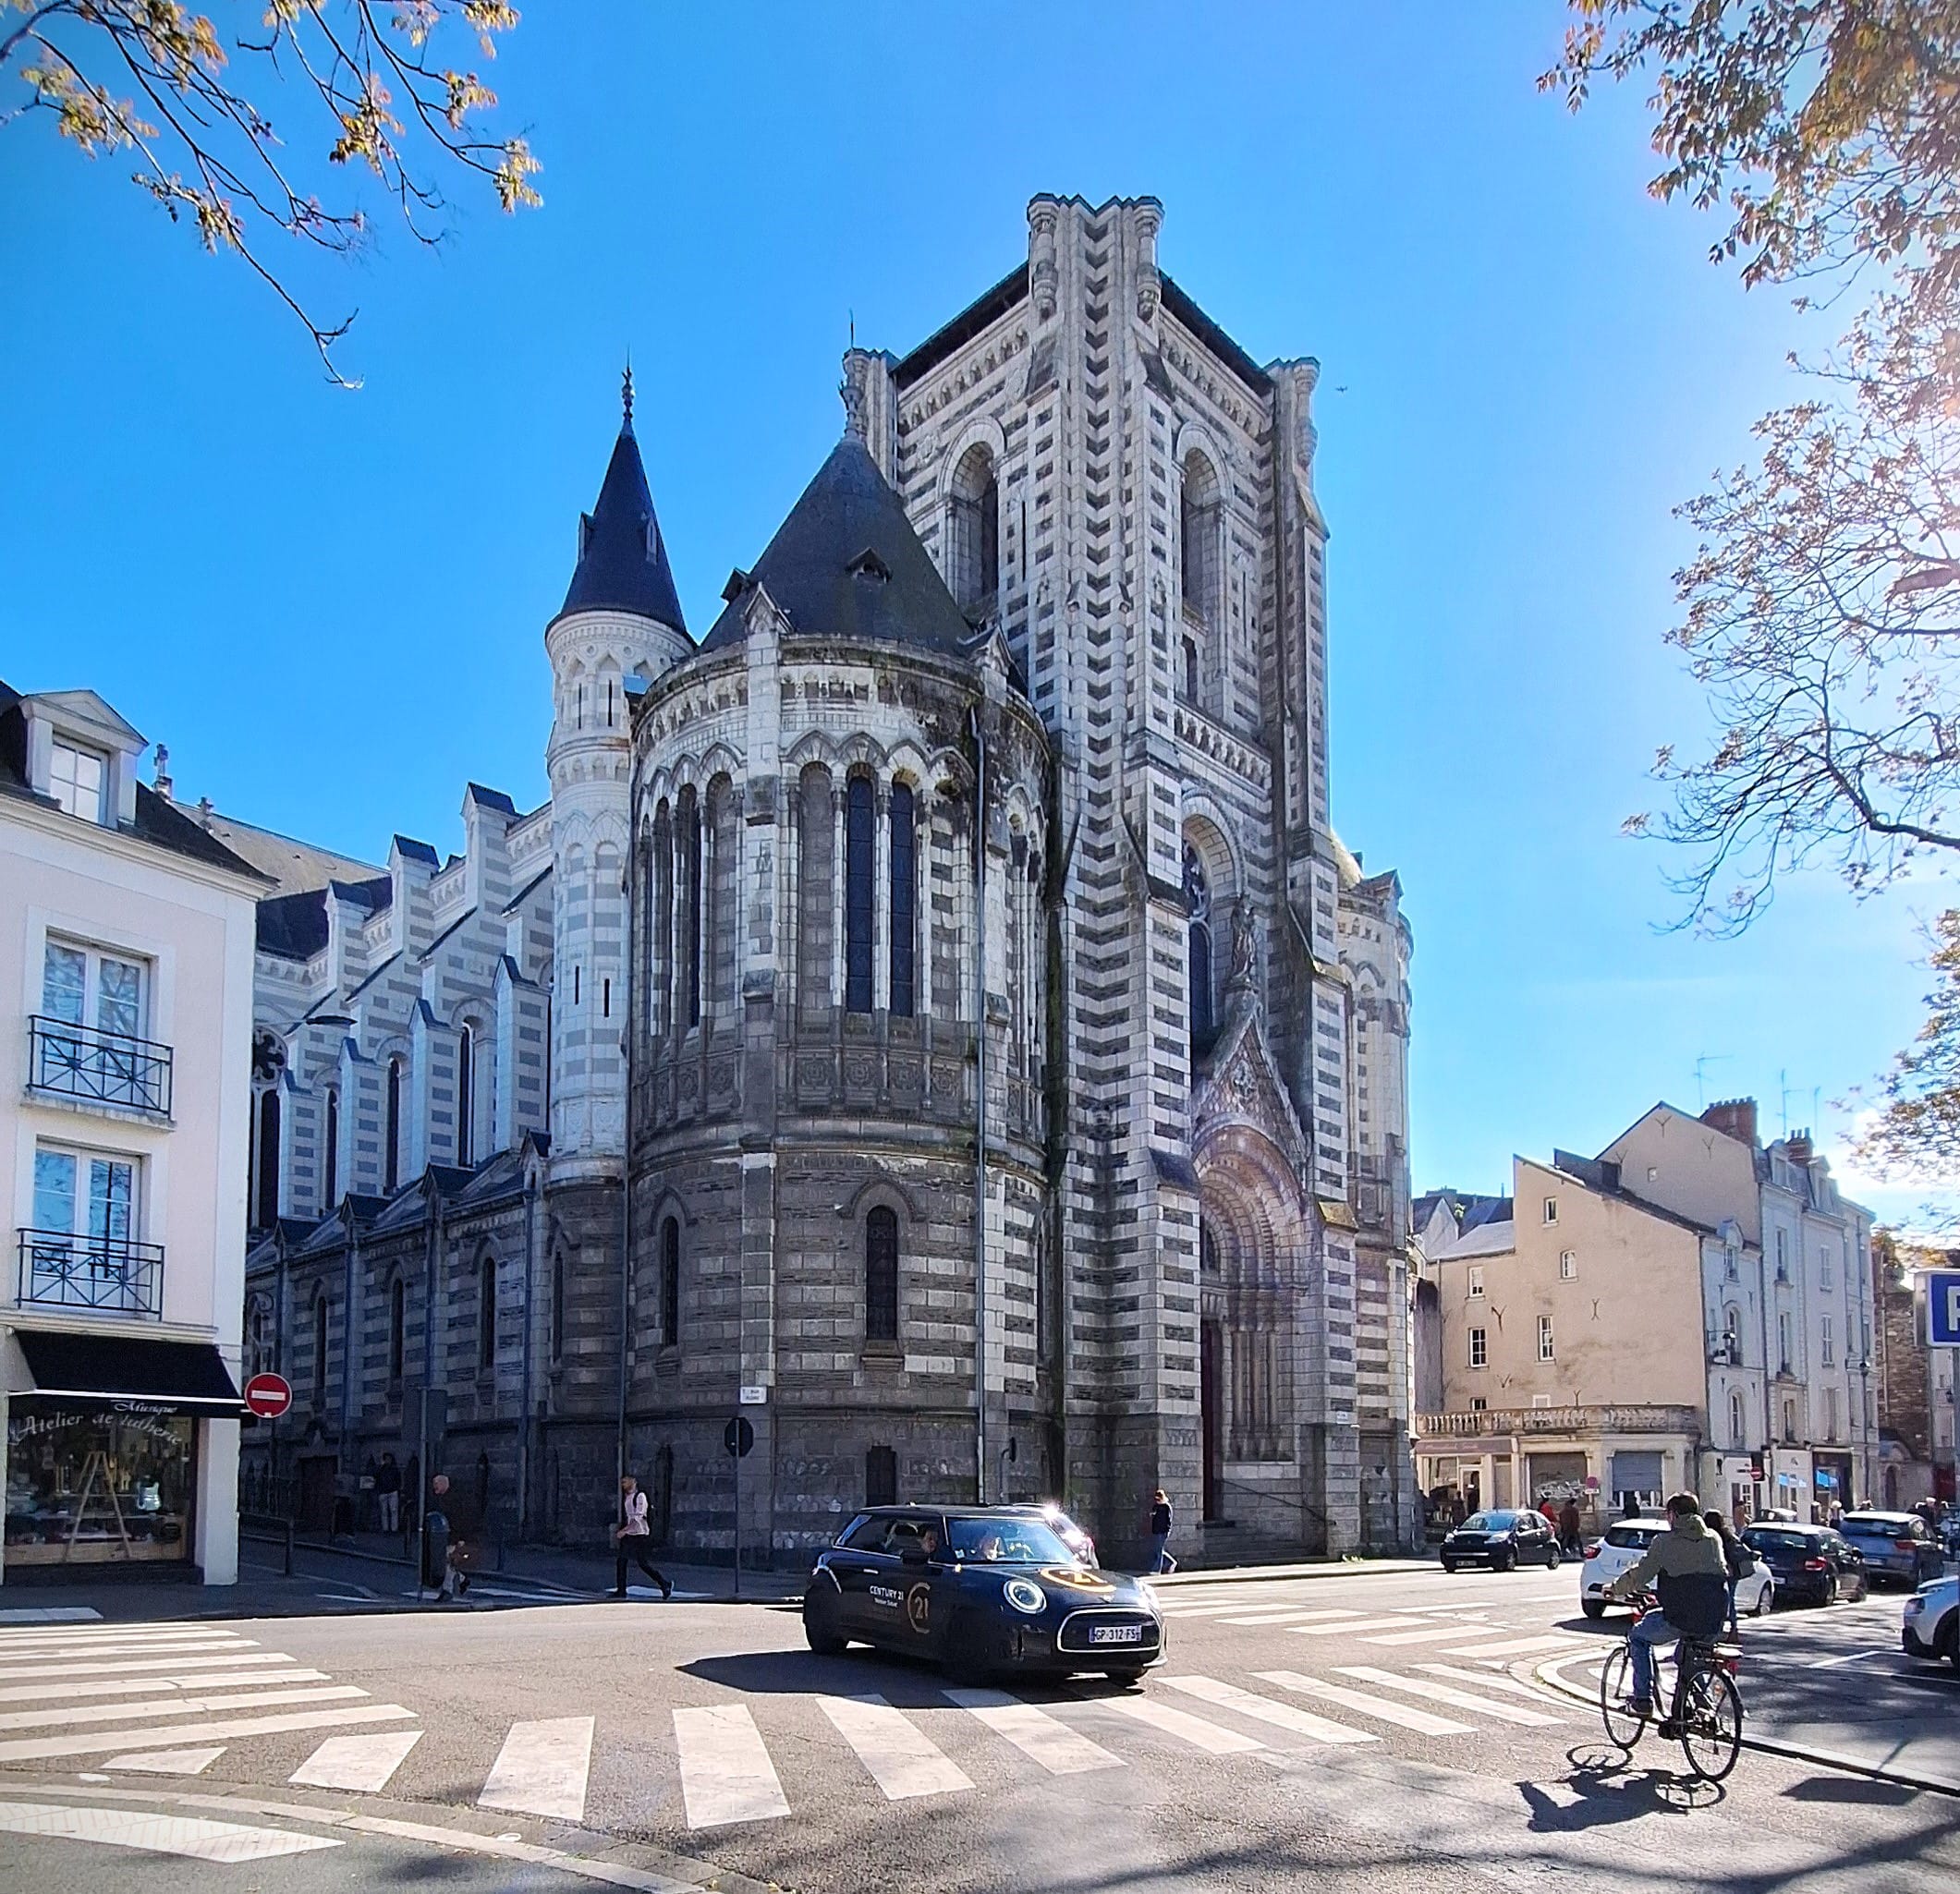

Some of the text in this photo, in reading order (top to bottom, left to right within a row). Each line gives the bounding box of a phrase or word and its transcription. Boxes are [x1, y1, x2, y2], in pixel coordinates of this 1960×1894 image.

[112, 1400, 178, 1415] Musique
[12, 1411, 85, 1443] Atelier
[92, 1413, 115, 1425] de
[870, 1584, 905, 1601] CENTURY 21
